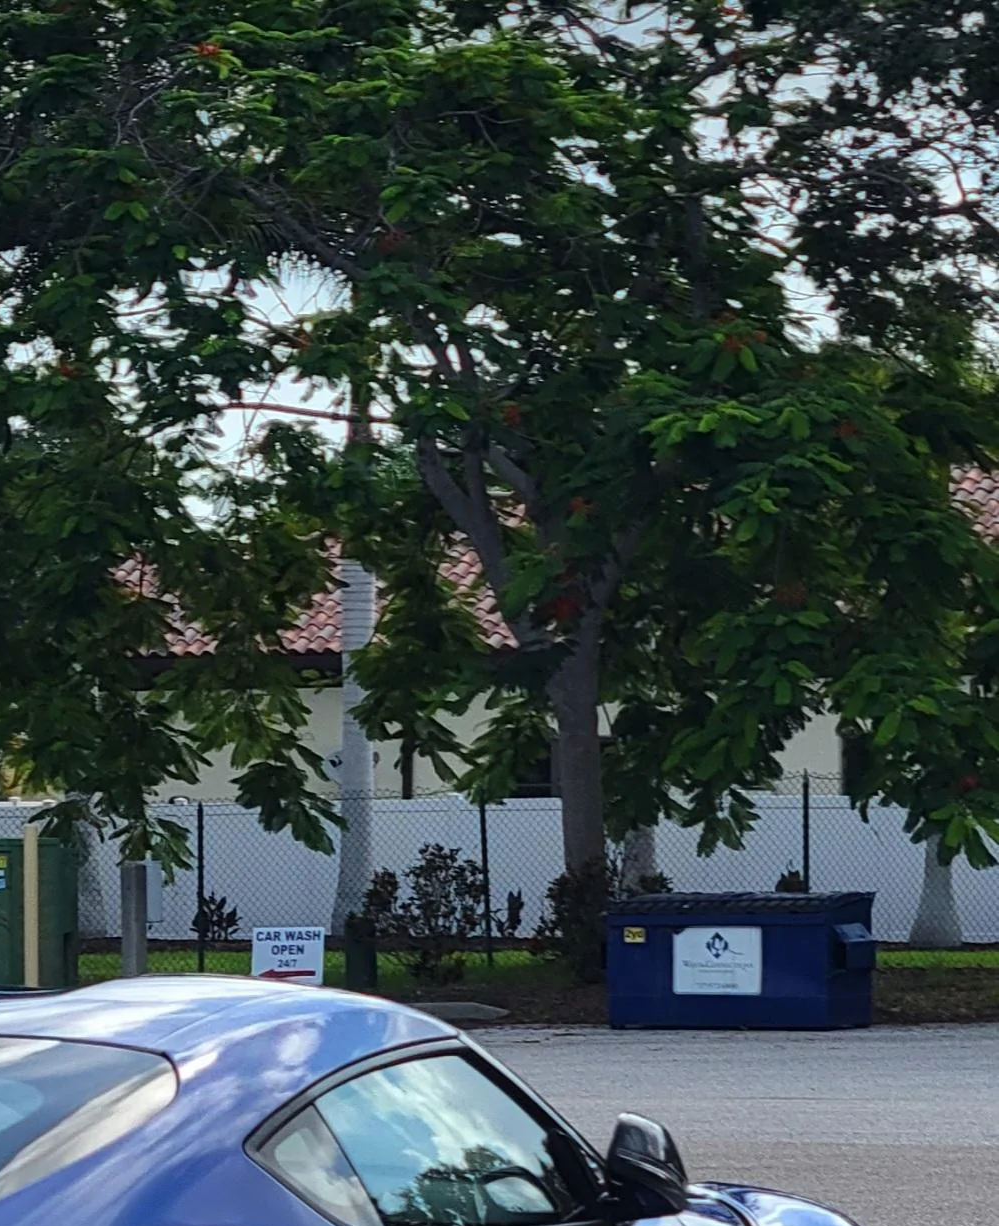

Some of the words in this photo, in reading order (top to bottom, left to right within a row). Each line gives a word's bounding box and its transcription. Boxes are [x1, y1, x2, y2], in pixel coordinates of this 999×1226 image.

[256, 931, 281, 942] CAR
[285, 930, 321, 942] WASH
[271, 944, 305, 956] OPEN
